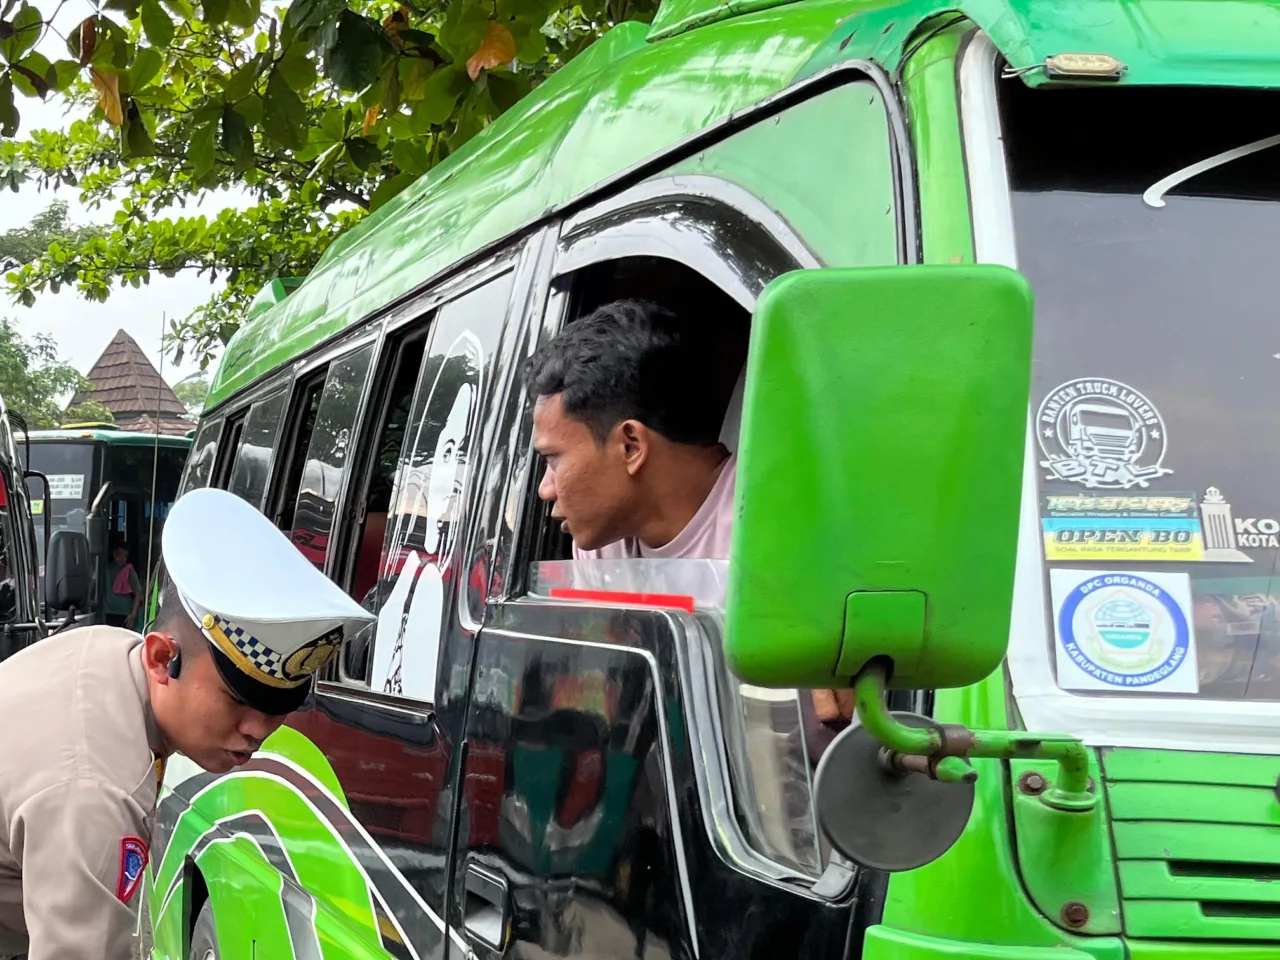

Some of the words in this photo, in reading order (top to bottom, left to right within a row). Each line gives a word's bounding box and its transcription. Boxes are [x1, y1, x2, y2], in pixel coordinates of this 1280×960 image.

[1042, 384, 1078, 424] BANTEN
[1076, 382, 1119, 395] TRUCK
[1119, 389, 1158, 425] LOVERS
[1050, 458, 1160, 479] BTL
[1054, 528, 1143, 544] OPEN
[1149, 528, 1193, 544] BO
[1237, 534, 1280, 547] KOTA
[1080, 578, 1103, 594] DPC
[1104, 576, 1161, 597] ORGANDA
[1066, 642, 1123, 684] KABUPATEN
[1125, 646, 1186, 685] PANDEGLANG
